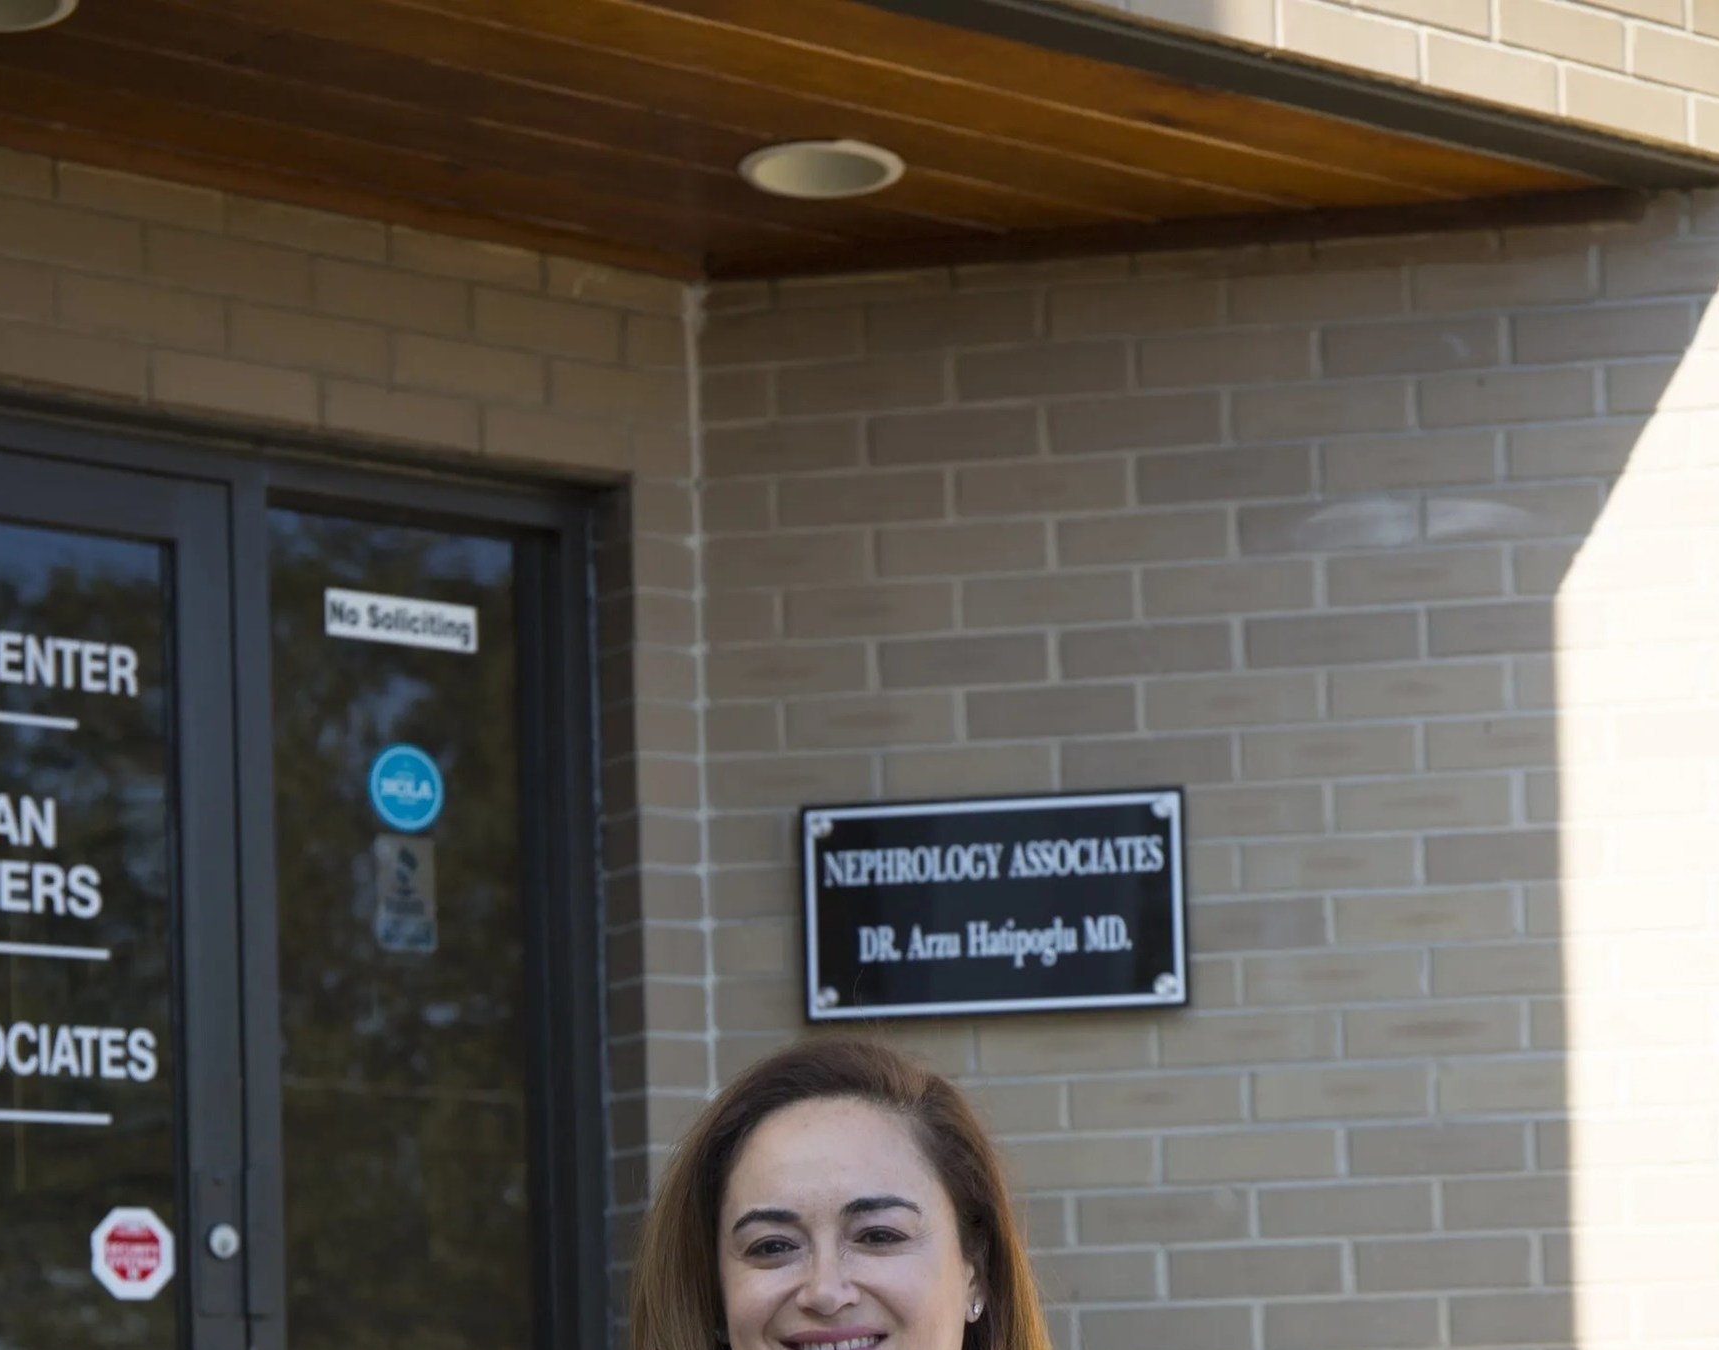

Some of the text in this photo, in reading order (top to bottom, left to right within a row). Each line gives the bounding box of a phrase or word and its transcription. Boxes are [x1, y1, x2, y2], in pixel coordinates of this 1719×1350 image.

[331, 600, 471, 646] No Soliciting
[824, 835, 1165, 887] NEPHROLOGY ASSOCIATES
[858, 914, 1133, 968] DR. Arzu Hatipoglu MD.
